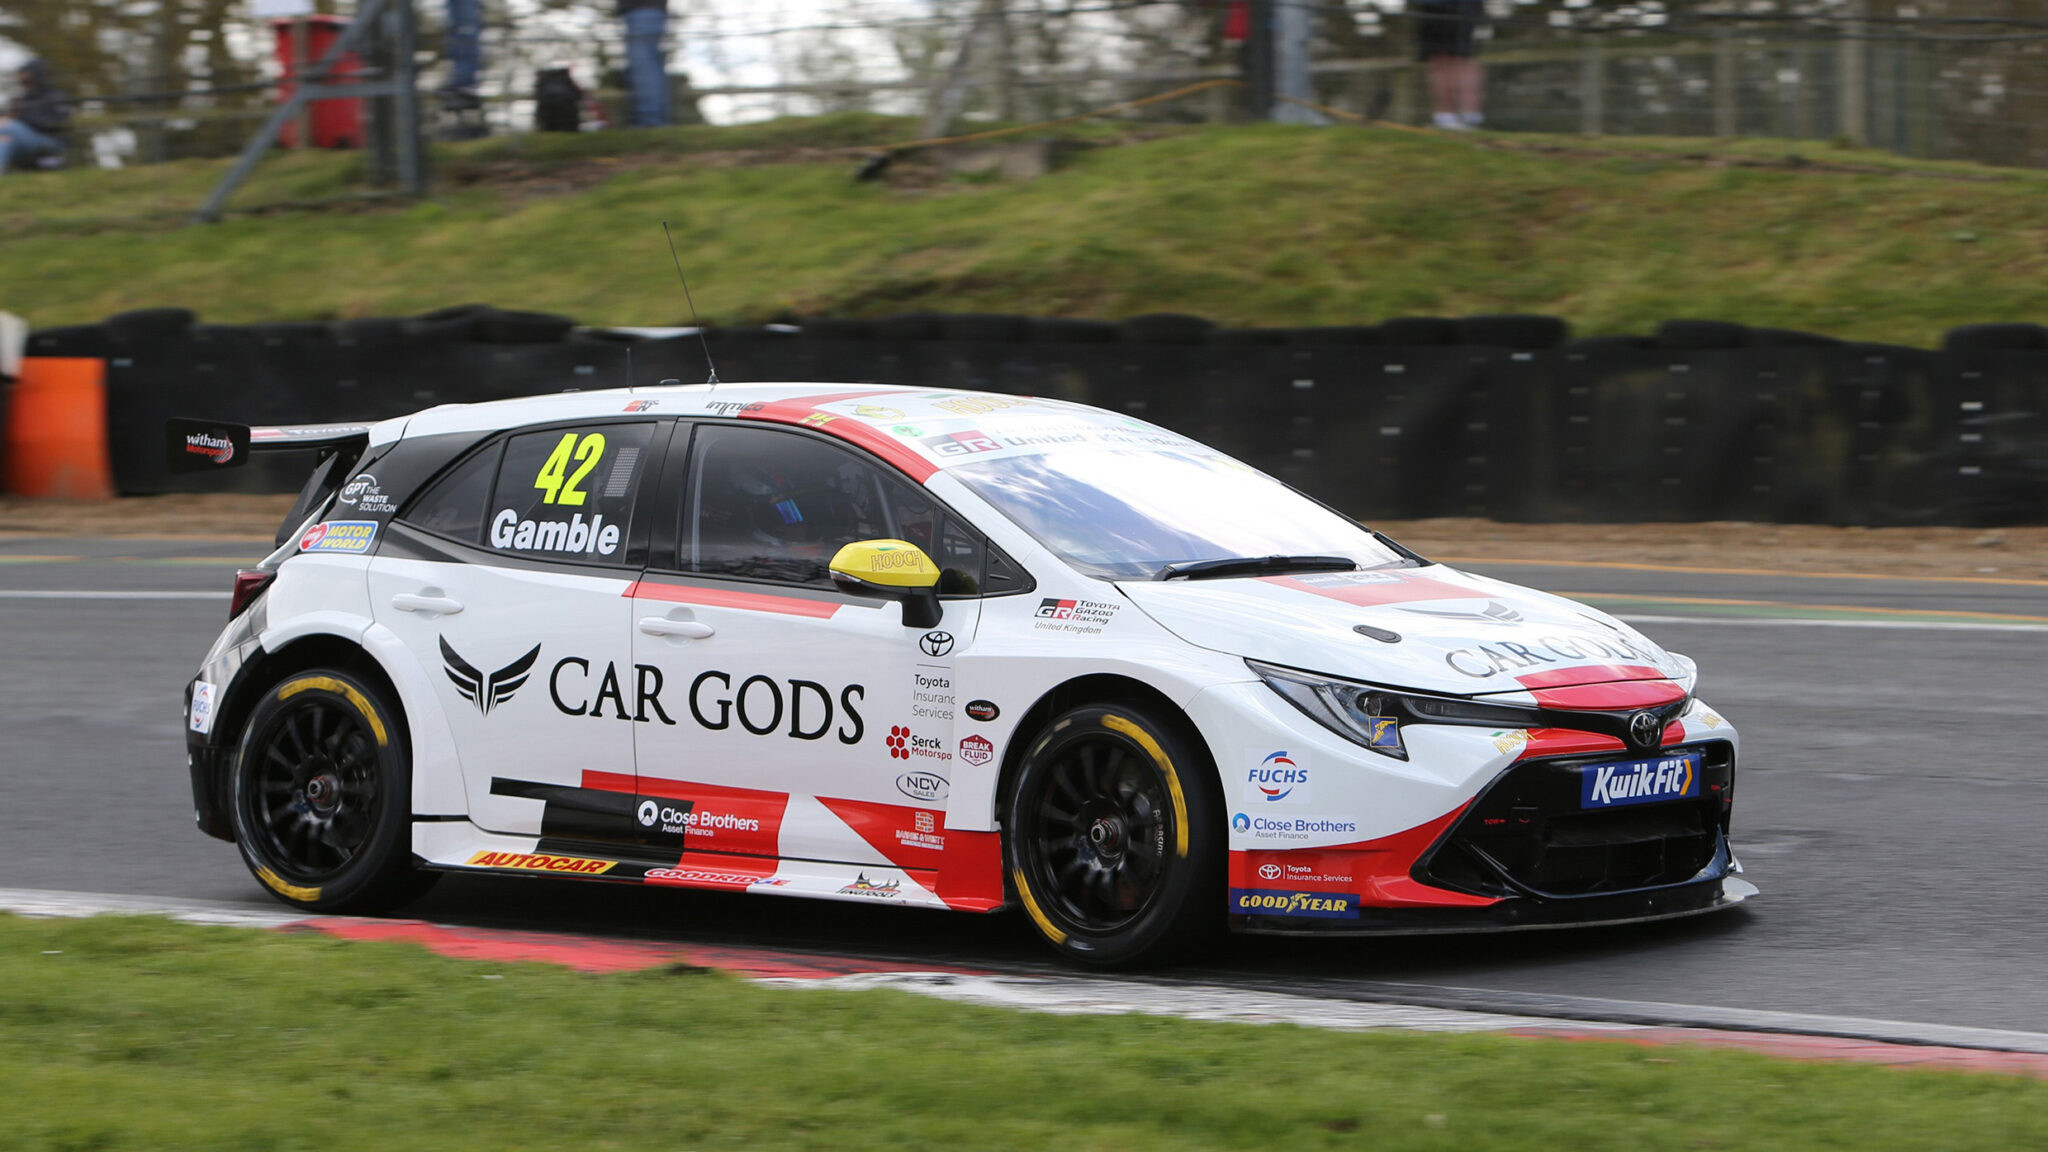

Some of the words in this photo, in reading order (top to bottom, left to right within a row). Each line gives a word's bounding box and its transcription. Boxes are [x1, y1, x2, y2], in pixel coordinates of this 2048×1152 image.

[186, 433, 228, 448] witham
[533, 432, 606, 506] 42
[345, 482, 370, 495] GPT
[366, 486, 381, 495] THE
[362, 494, 389, 503] WASTE
[358, 502, 398, 512] SOLUTION
[327, 525, 373, 538] MOTOR
[490, 508, 620, 556] Gamble
[320, 538, 367, 549] WORLD
[871, 549, 924, 573] HOOCH
[1035, 604, 1074, 620] GR
[1079, 600, 1121, 610] TOYOTA
[1071, 614, 1109, 625] Racing
[1075, 608, 1114, 617] GAZOO
[1034, 621, 1062, 631] United
[1063, 623, 1102, 634] Kingdom
[1445, 640, 1557, 679] CAR
[914, 673, 951, 689] Toyota
[549, 655, 677, 725] CAR
[688, 669, 866, 746] GODS
[912, 690, 957, 705] Insuranc
[911, 704, 955, 721] Services
[911, 734, 942, 750] Serck
[962, 740, 990, 751] BREAK
[911, 747, 953, 761] Motorspo
[964, 750, 988, 760] FLUID
[1247, 769, 1309, 783] FUCHS
[906, 776, 941, 791] NCV
[912, 789, 935, 798] SALES
[660, 806, 698, 826] Close
[700, 810, 760, 832] Brothers
[1253, 817, 1293, 831] Close
[1295, 819, 1356, 832] Brothers
[661, 823, 684, 834] Asset
[684, 825, 714, 837] Finance
[1254, 830, 1278, 839] Asset
[1278, 831, 1309, 840] Finance
[473, 851, 608, 873] AUTOCAR
[1286, 864, 1312, 874] Toyota
[644, 867, 792, 887] GOODRIDGE
[1286, 873, 1322, 882] Insurance
[1323, 874, 1353, 883] Services
[1239, 893, 1349, 913] GOODYEAR
